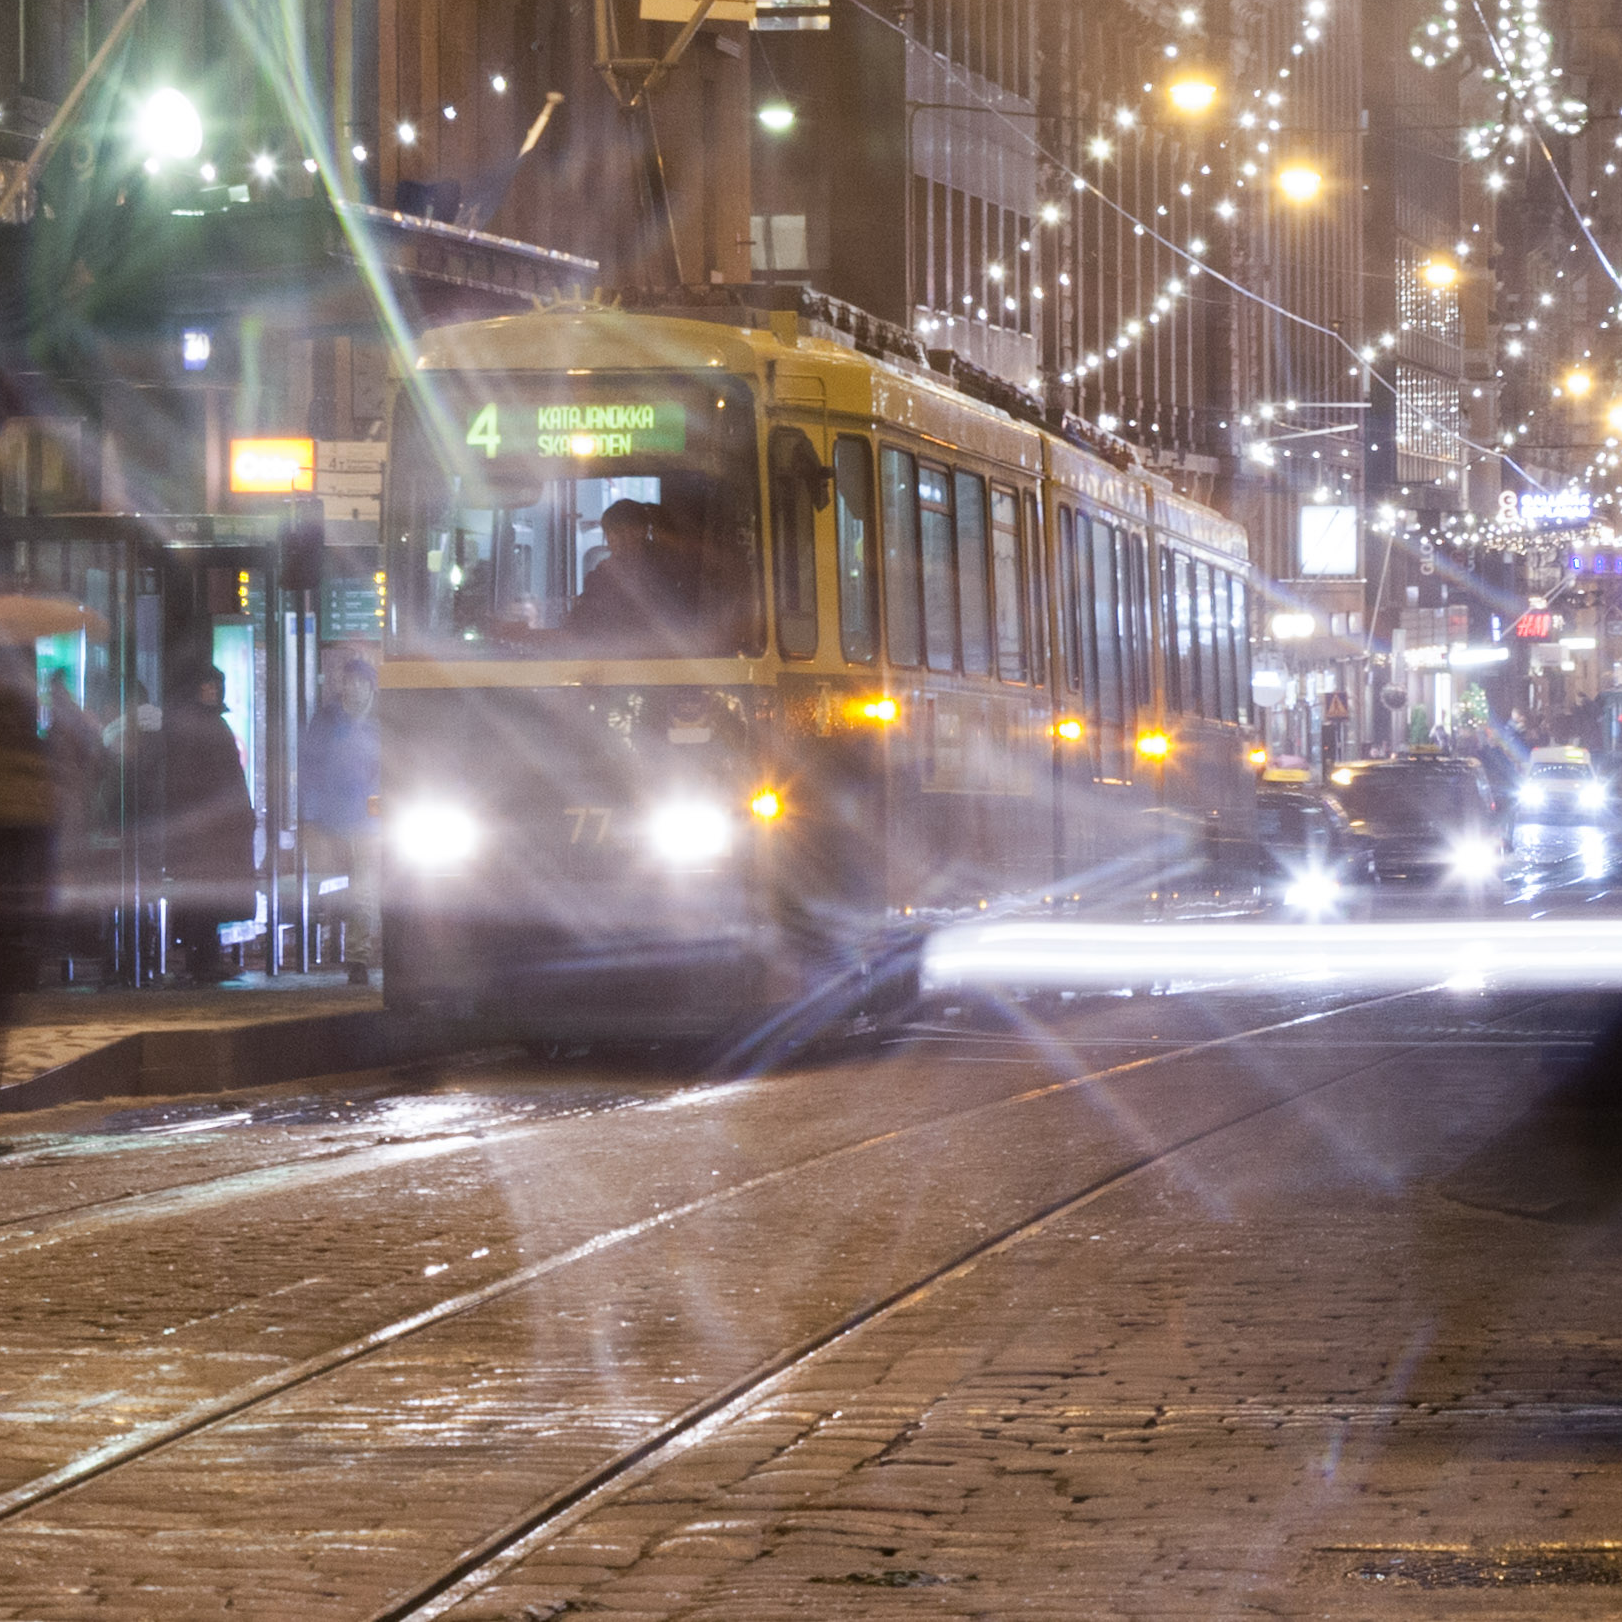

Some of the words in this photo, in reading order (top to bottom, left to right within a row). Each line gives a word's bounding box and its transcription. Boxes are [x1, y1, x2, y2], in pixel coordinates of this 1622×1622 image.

[466, 402, 501, 459] 4
[538, 404, 655, 430] KATAJANOKKA
[538, 433, 633, 458] SKADDEN
[563, 807, 613, 845] 77
